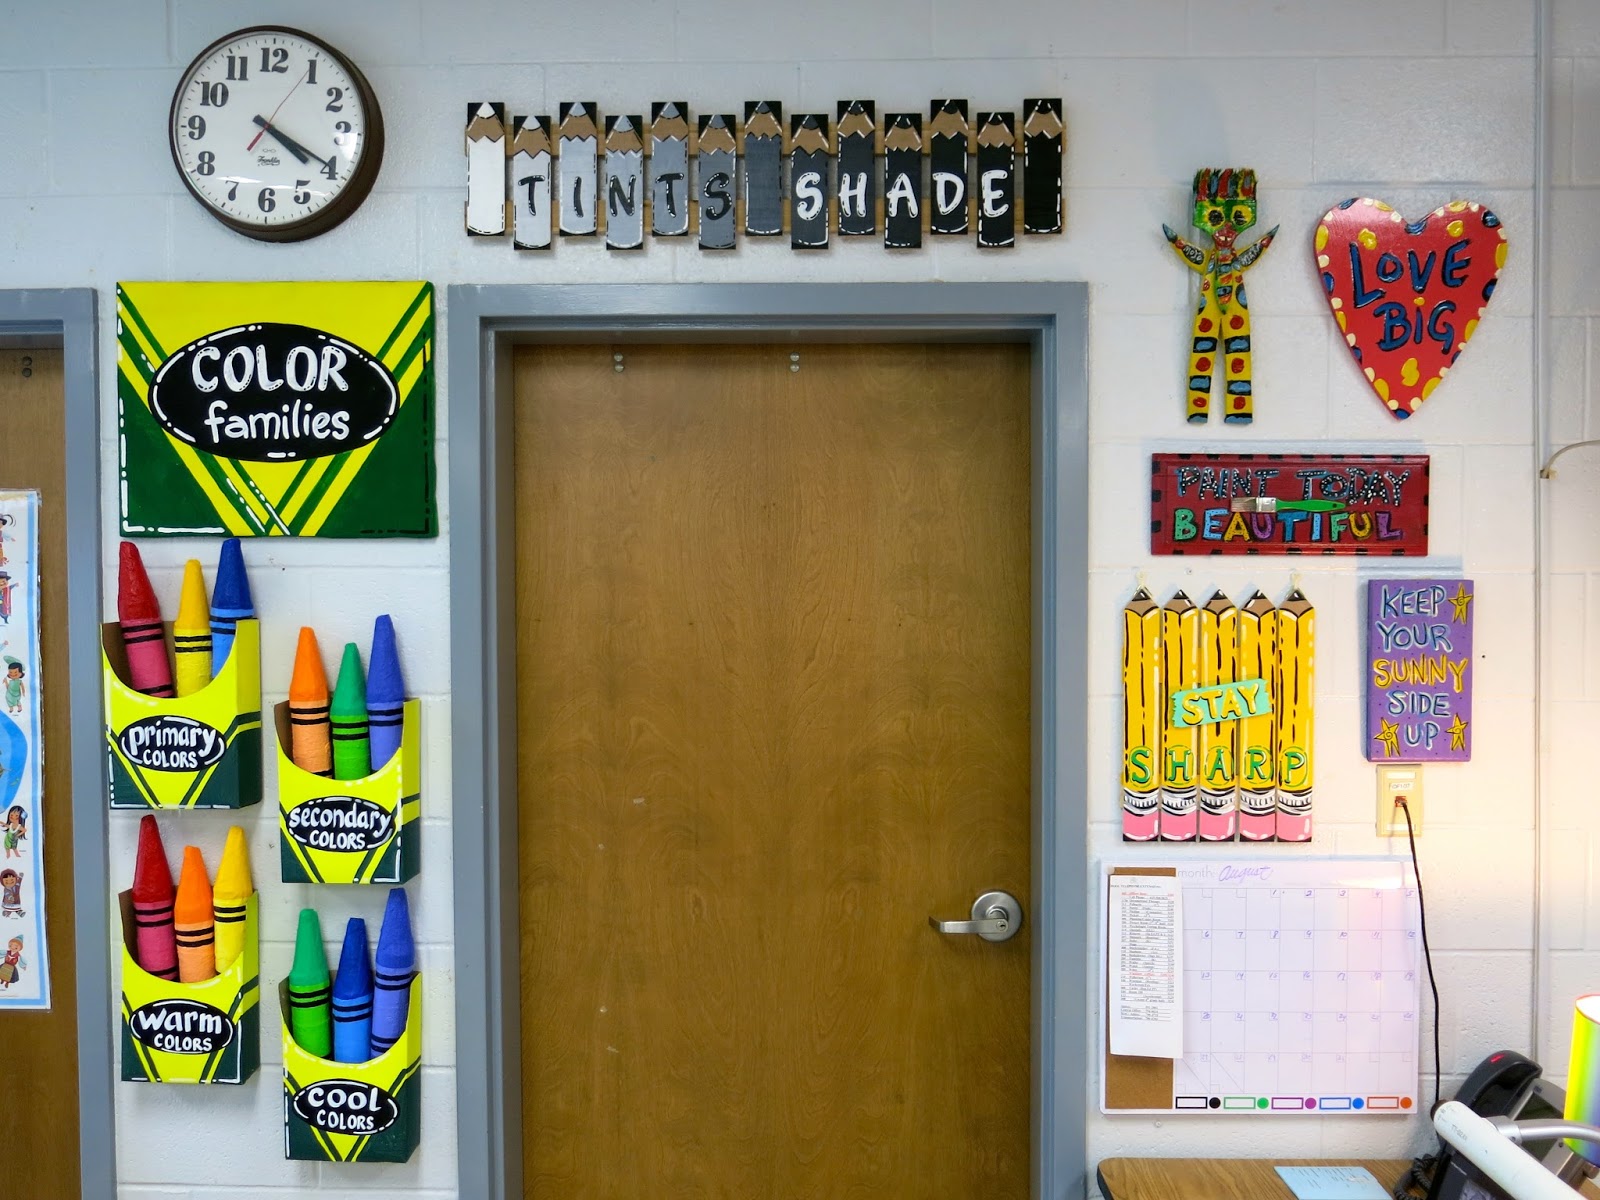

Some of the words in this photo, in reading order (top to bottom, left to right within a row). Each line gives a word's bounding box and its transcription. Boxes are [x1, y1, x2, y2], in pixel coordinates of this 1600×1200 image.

[225, 56, 248, 81] 11
[260, 48, 289, 73] 12
[306, 59, 317, 84] 1
[200, 81, 229, 107] 10
[325, 87, 344, 112] 2
[187, 115, 206, 140] 9
[333, 121, 351, 146] 3
[197, 151, 215, 176] 8
[320, 155, 338, 180] 4
[225, 180, 240, 201] 7
[258, 187, 276, 213] 6
[293, 179, 311, 204] 5
[517, 171, 733, 221] TINTS
[795, 169, 1009, 221] SHADE
[1348, 238, 1472, 309] LOVE
[191, 344, 349, 393] COLOR
[204, 399, 350, 443] families
[1175, 465, 1280, 501] PAINT
[1294, 466, 1411, 507] TODAY
[1173, 508, 1404, 542] BEAUTIFUL
[1380, 585, 1447, 619] KEEP
[1375, 621, 1453, 653] YOUR
[1373, 653, 1469, 693] SUNNY
[1181, 683, 1259, 726] STAY
[1386, 690, 1452, 717] SIDE
[128, 721, 217, 757] primary
[1404, 720, 1441, 750] UP
[142, 750, 199, 769] COLORS
[1130, 748, 1306, 784] SHARP
[289, 801, 392, 838] secondary
[309, 829, 366, 849] COLORS
[153, 1033, 213, 1051] COLORS
[316, 1109, 374, 1130] COLORS
